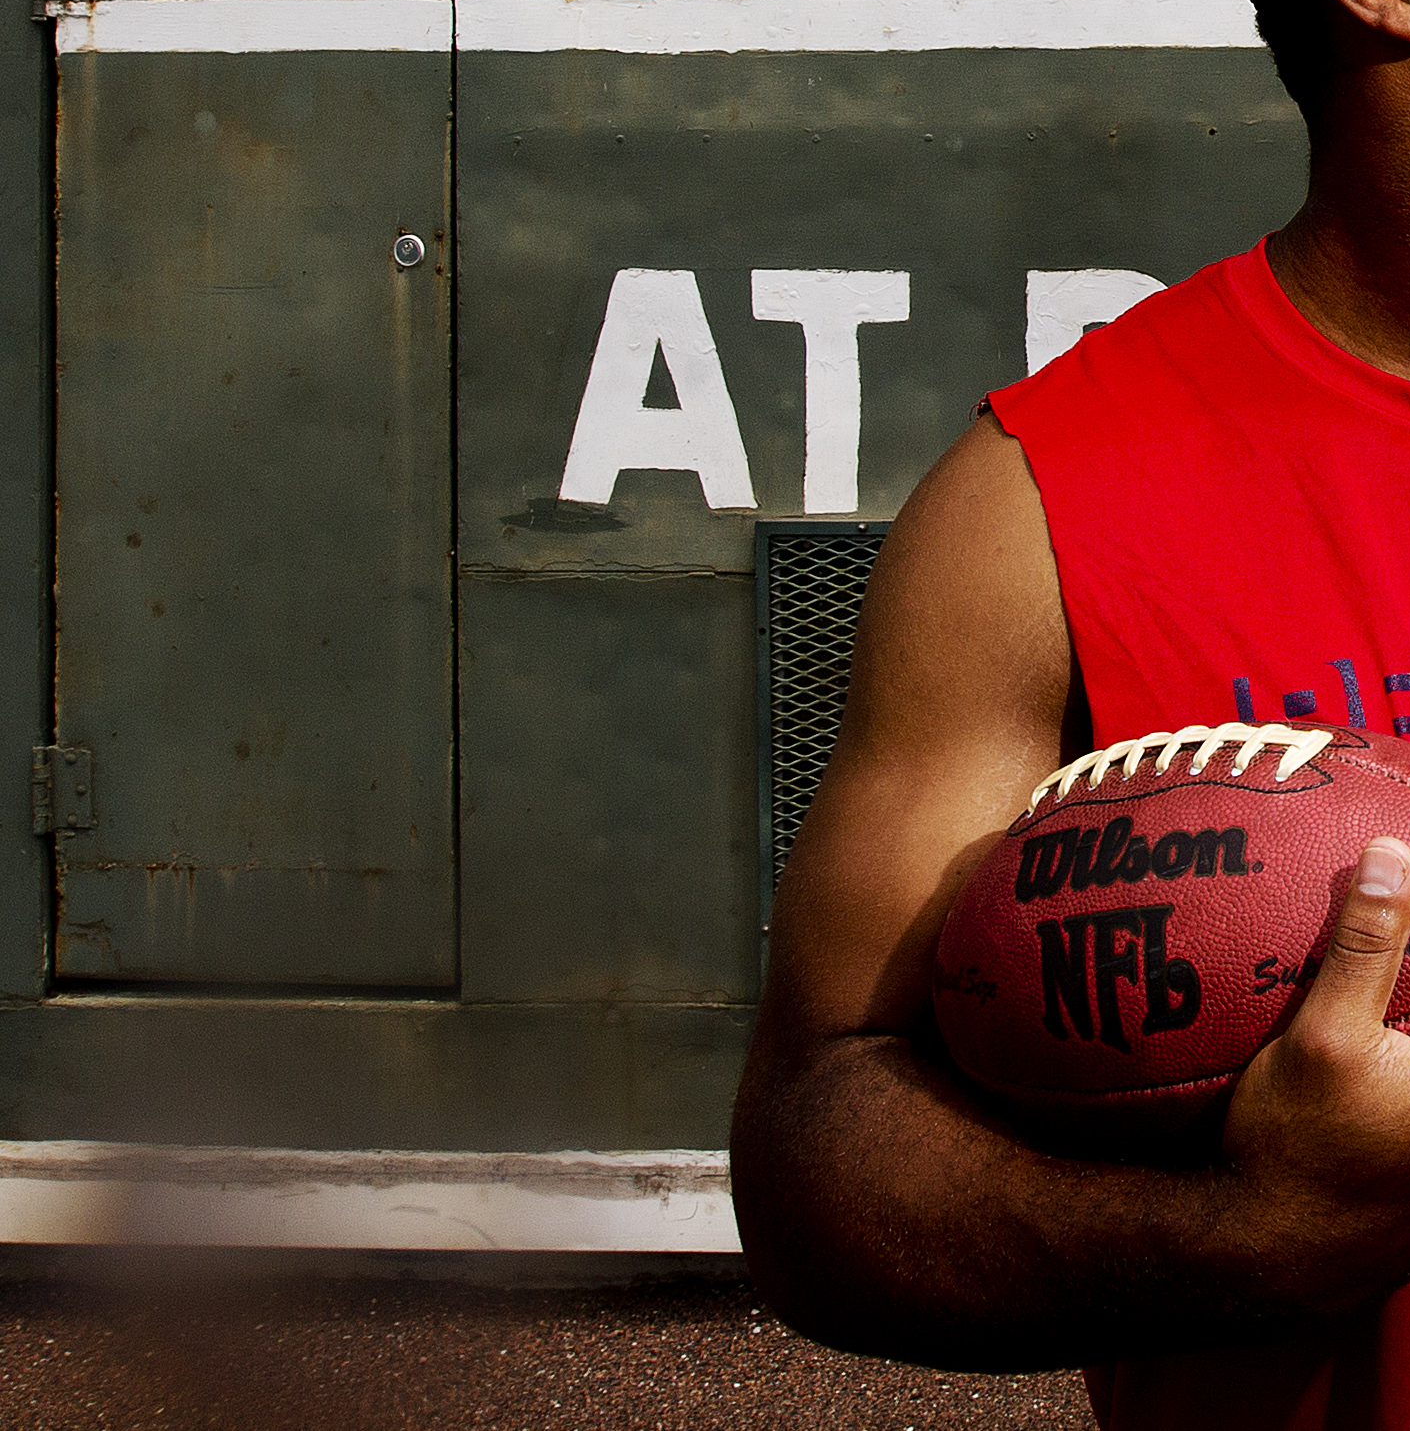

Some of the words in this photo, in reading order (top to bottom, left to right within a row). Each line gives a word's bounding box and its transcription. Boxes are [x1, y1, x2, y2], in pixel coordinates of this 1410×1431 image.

[558, 267, 911, 515] AT
[1014, 815, 1250, 904] Wilson
[1036, 902, 1201, 1055] NFL
